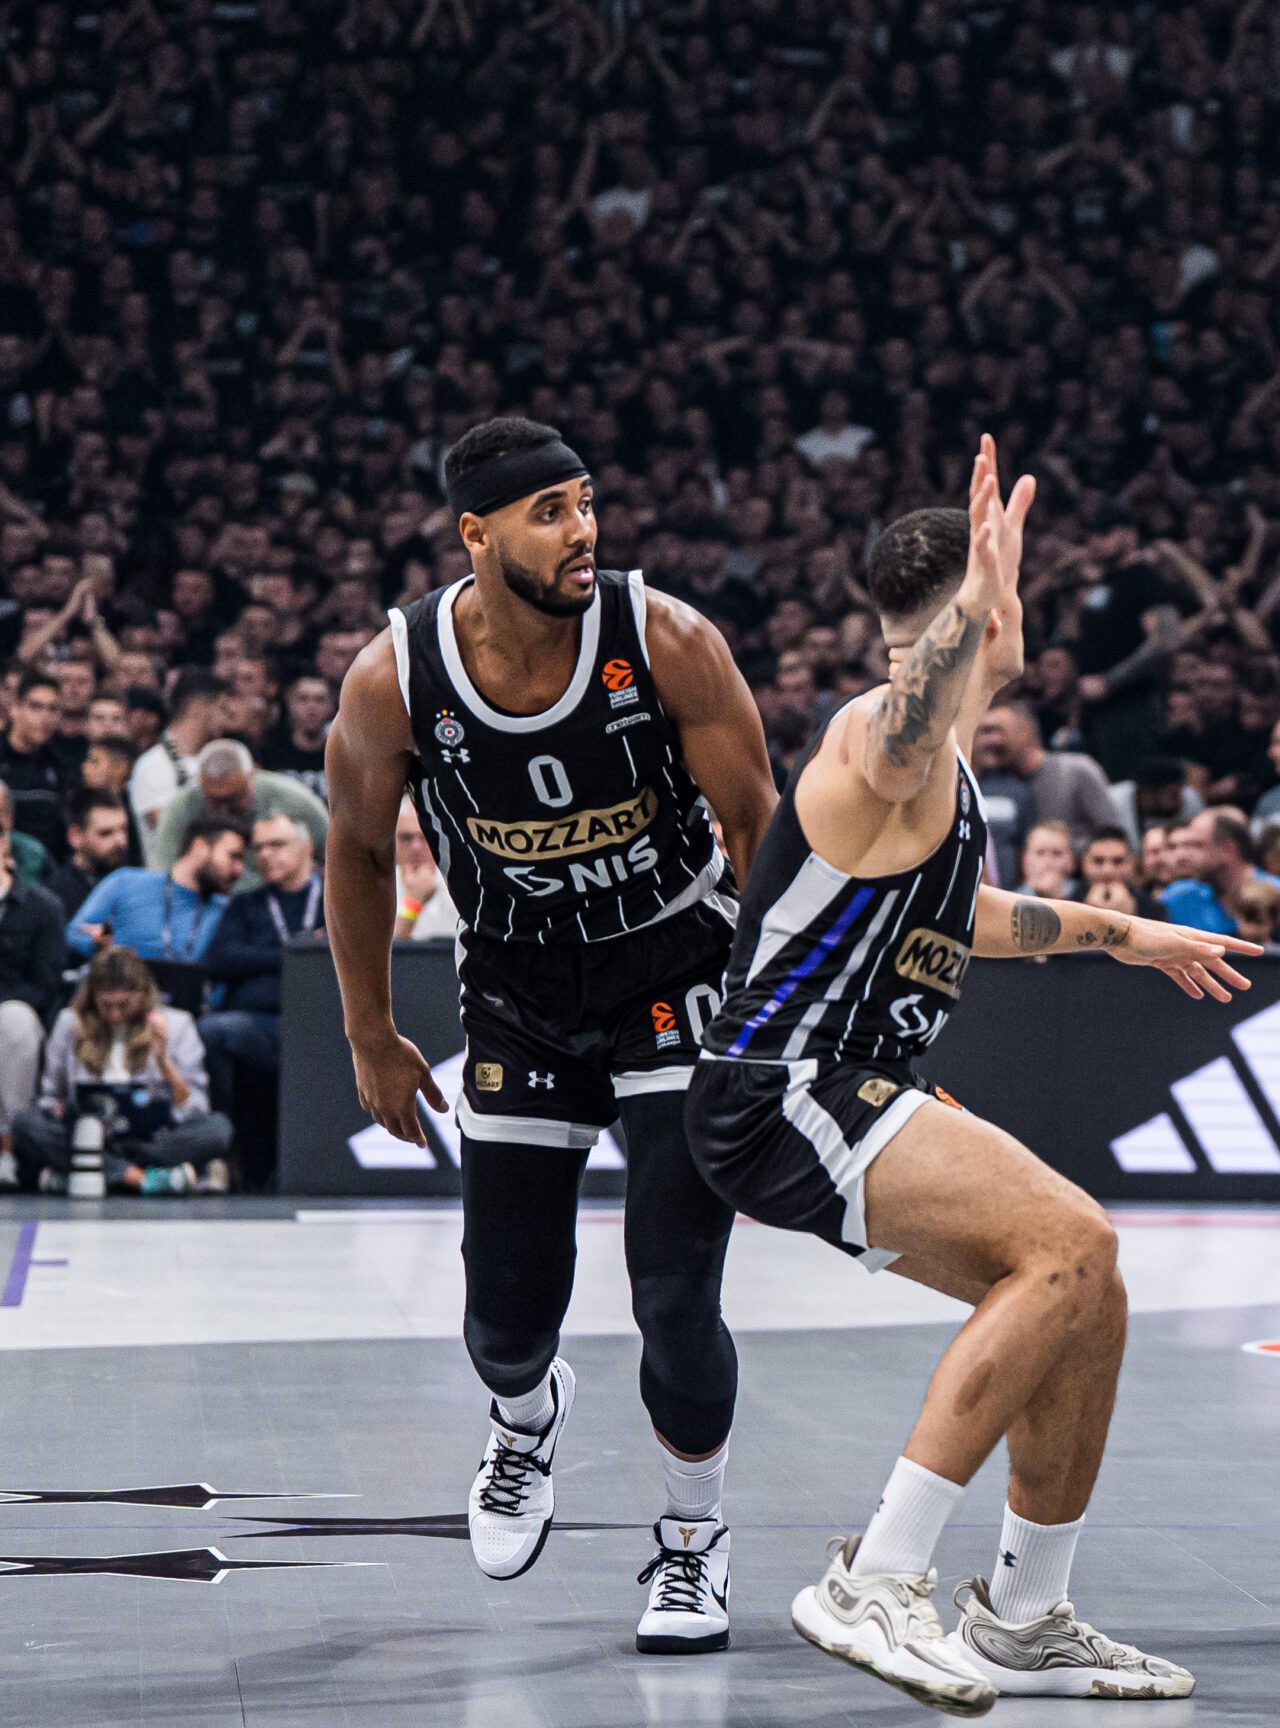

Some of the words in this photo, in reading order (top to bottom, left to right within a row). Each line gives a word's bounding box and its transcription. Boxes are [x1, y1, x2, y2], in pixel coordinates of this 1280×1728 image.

[527, 754, 574, 808] 0
[474, 801, 653, 854] MOZZART
[568, 834, 658, 893] NIS
